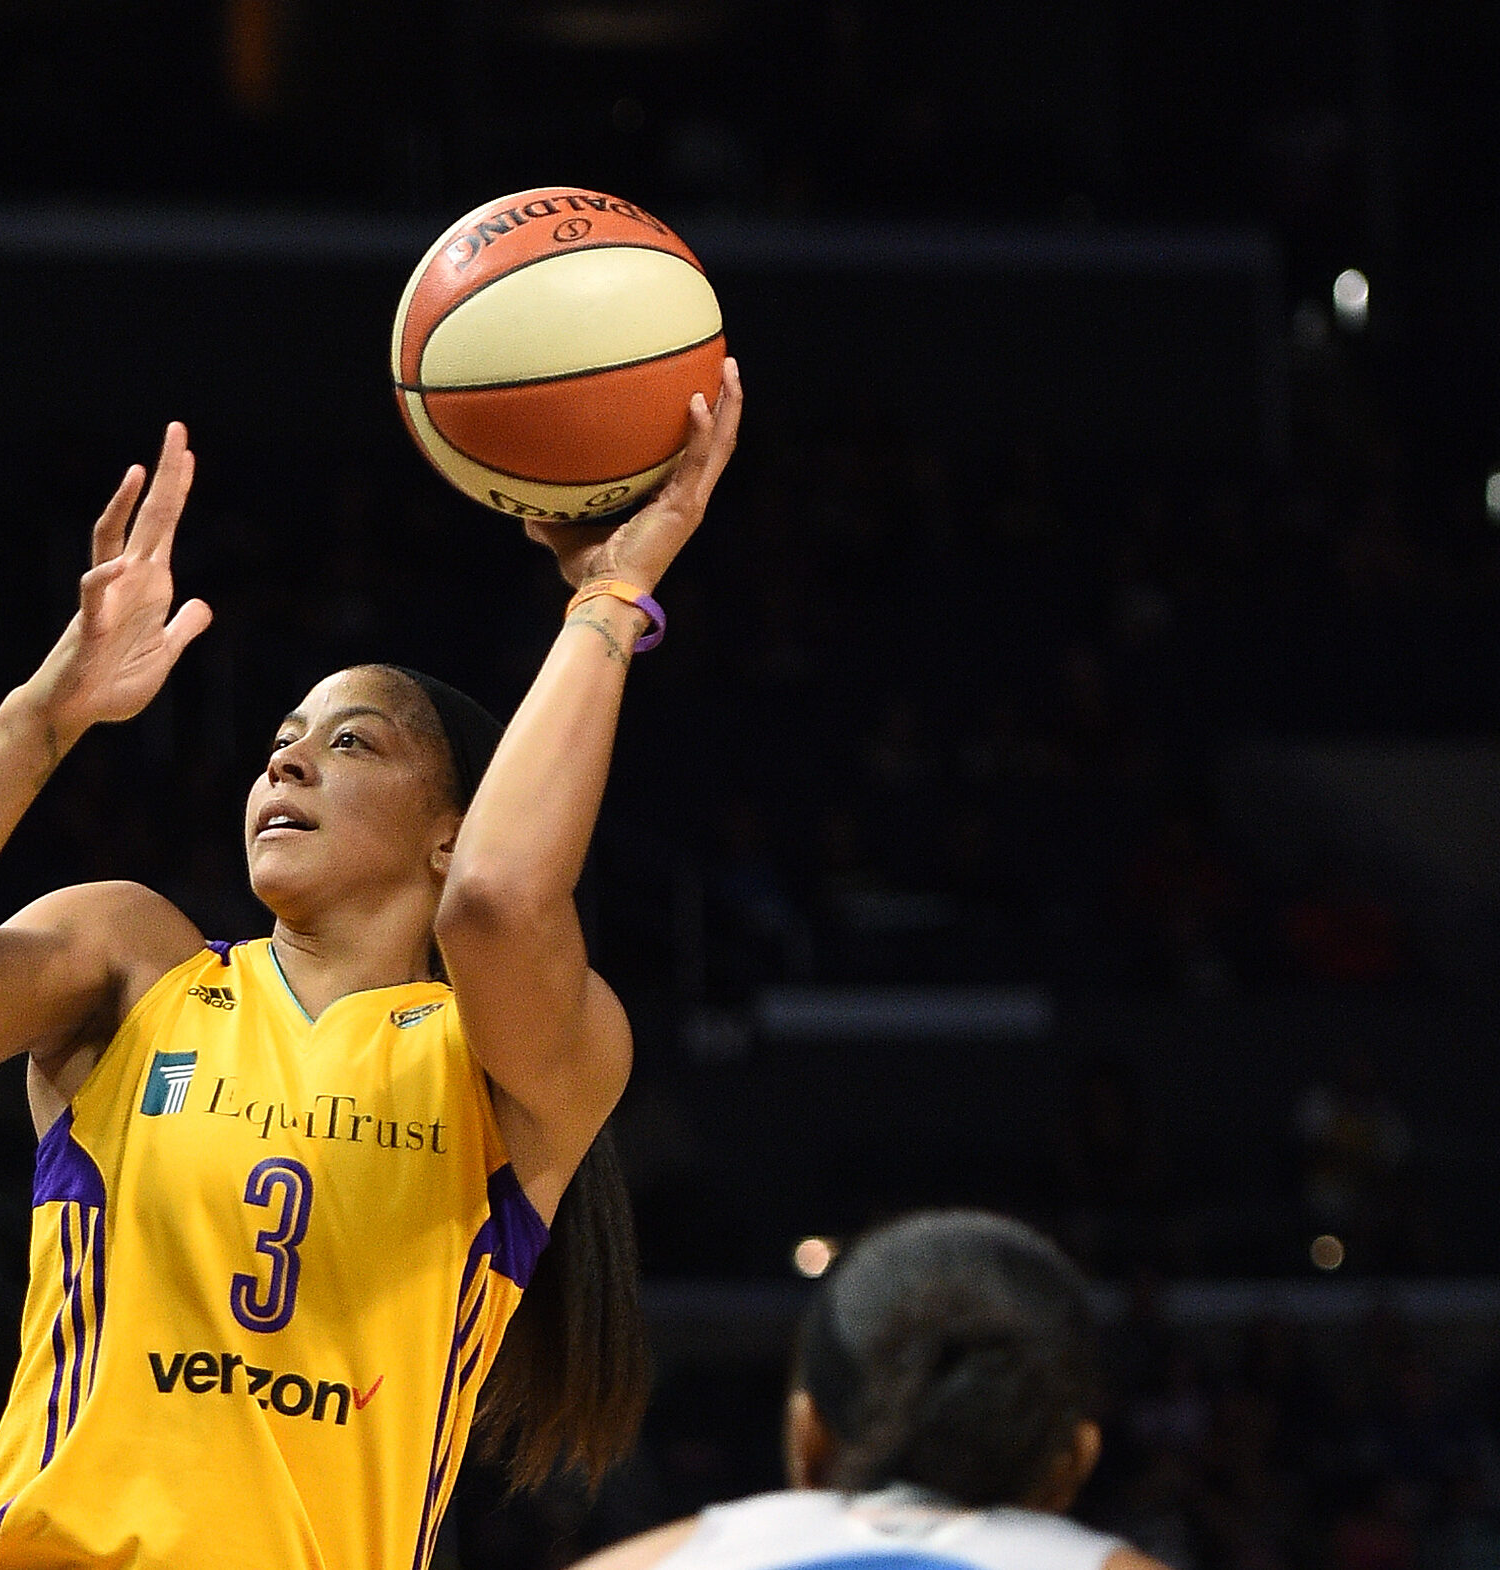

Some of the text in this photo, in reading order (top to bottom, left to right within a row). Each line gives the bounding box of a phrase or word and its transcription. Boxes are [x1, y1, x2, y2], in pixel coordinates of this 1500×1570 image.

[188, 987, 236, 1011] adida
[204, 1076, 447, 1154] EquiTrust
[230, 1157, 313, 1334] 3
[148, 1351, 352, 1426] verzon
